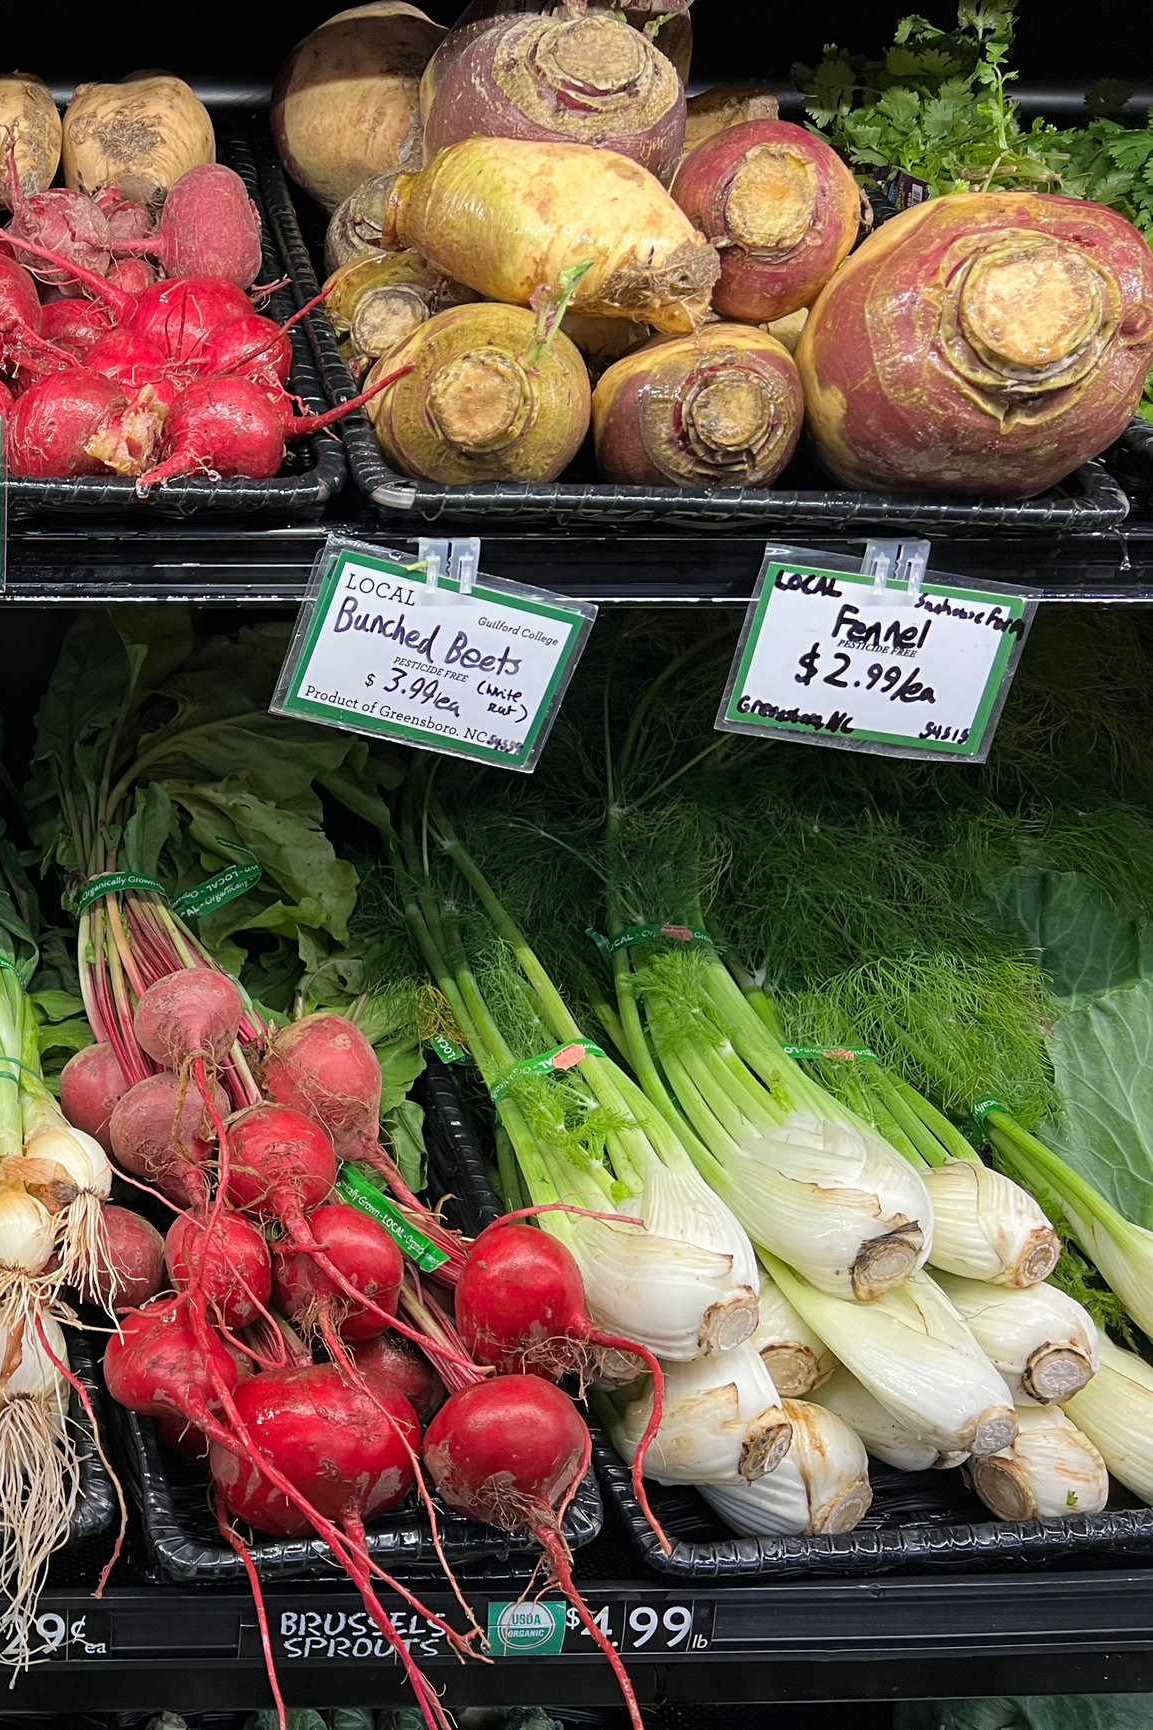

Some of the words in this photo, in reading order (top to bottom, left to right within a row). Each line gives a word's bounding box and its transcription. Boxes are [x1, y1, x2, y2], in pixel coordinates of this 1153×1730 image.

[345, 573, 416, 606] LOCAL
[333, 596, 441, 664] Bunched
[444, 631, 522, 676] Beets
[478, 616, 520, 637] Guilford
[521, 628, 559, 646] College
[831, 604, 932, 649] Fennel
[838, 639, 890, 655] PESTICIDE
[891, 645, 918, 658] FREE
[365, 672, 376, 688] $
[393, 656, 443, 678] PESTICIDE
[443, 669, 469, 683] FREE
[305, 685, 359, 710] Product
[361, 700, 378, 713] of
[463, 727, 488, 743] NC
[381, 1214, 405, 1238] LOCAL
[511, 1614, 541, 1625] USDA
[507, 1628, 544, 1638] ORGANIC
[692, 1634, 708, 1649] lb
